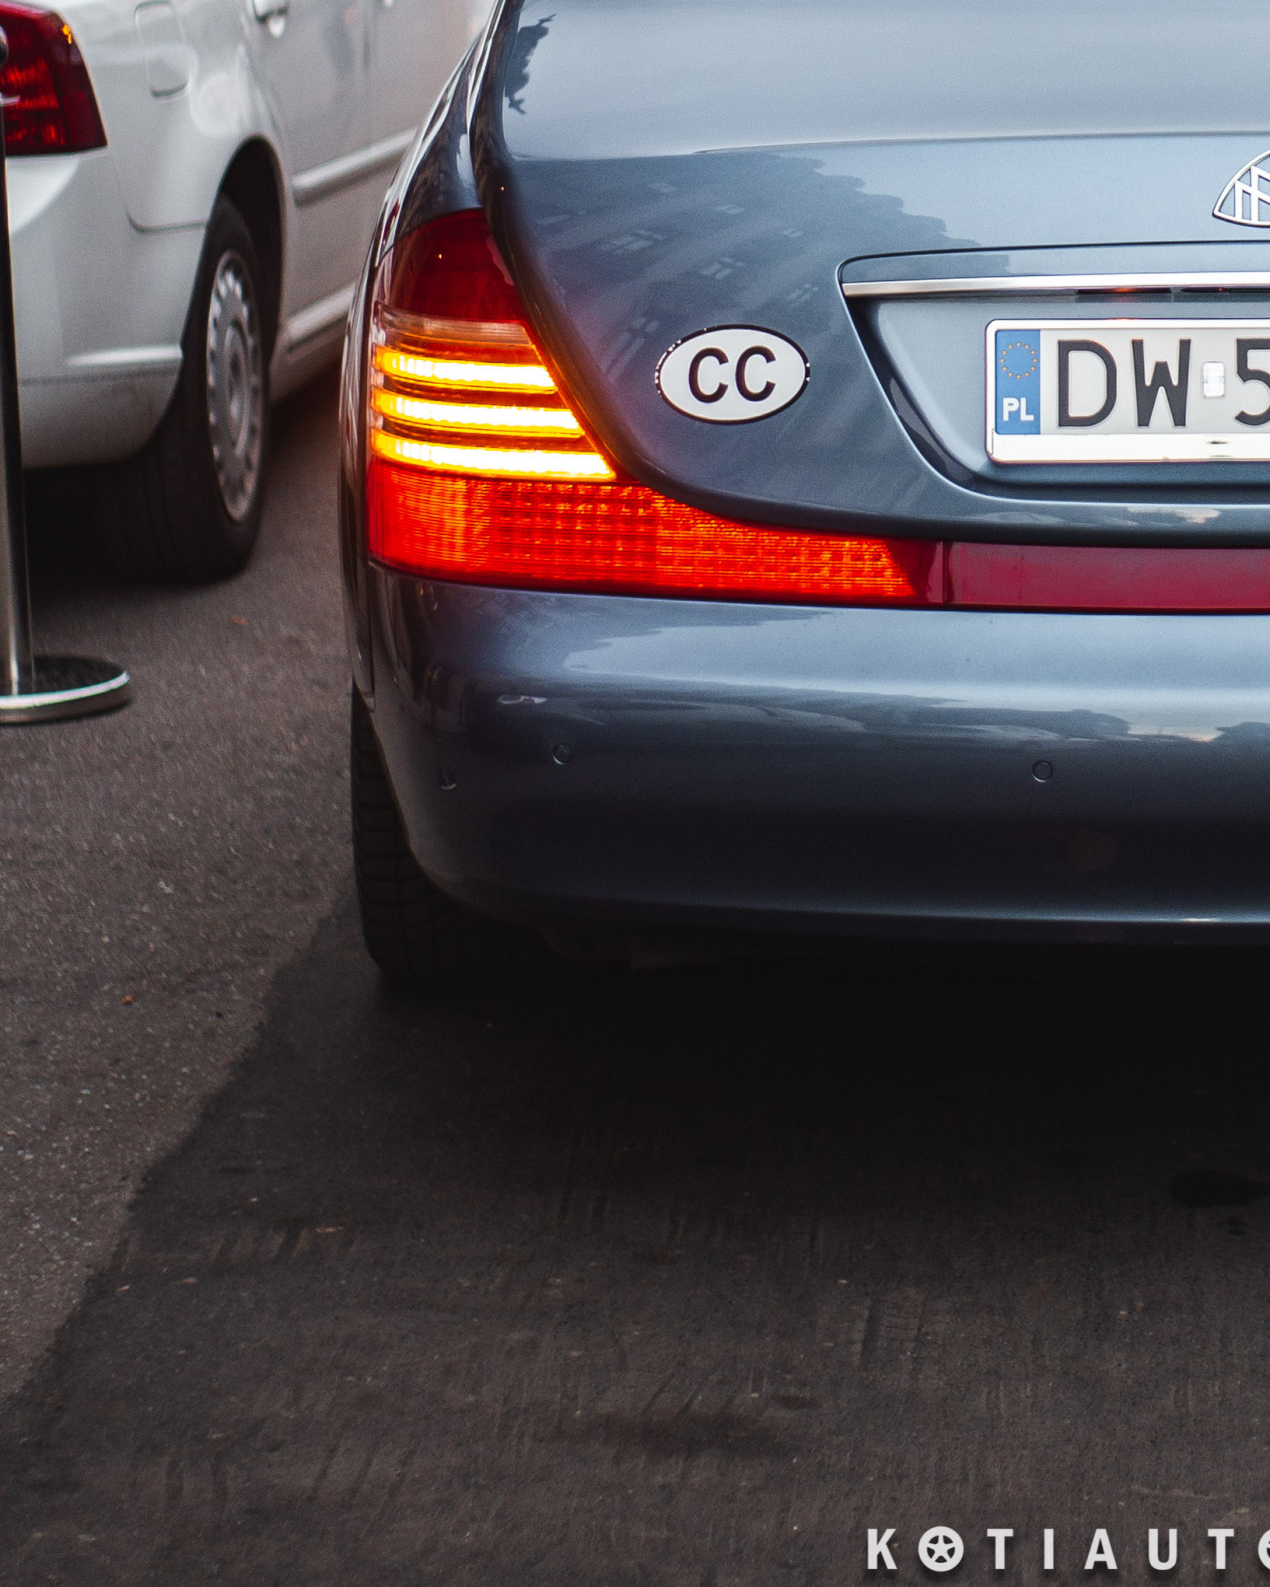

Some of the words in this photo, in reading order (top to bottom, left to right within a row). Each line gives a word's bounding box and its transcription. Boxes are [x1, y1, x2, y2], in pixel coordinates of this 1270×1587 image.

[688, 344, 777, 404] CC
[1056, 337, 1192, 428] DW
[1002, 396, 1034, 422] PL
